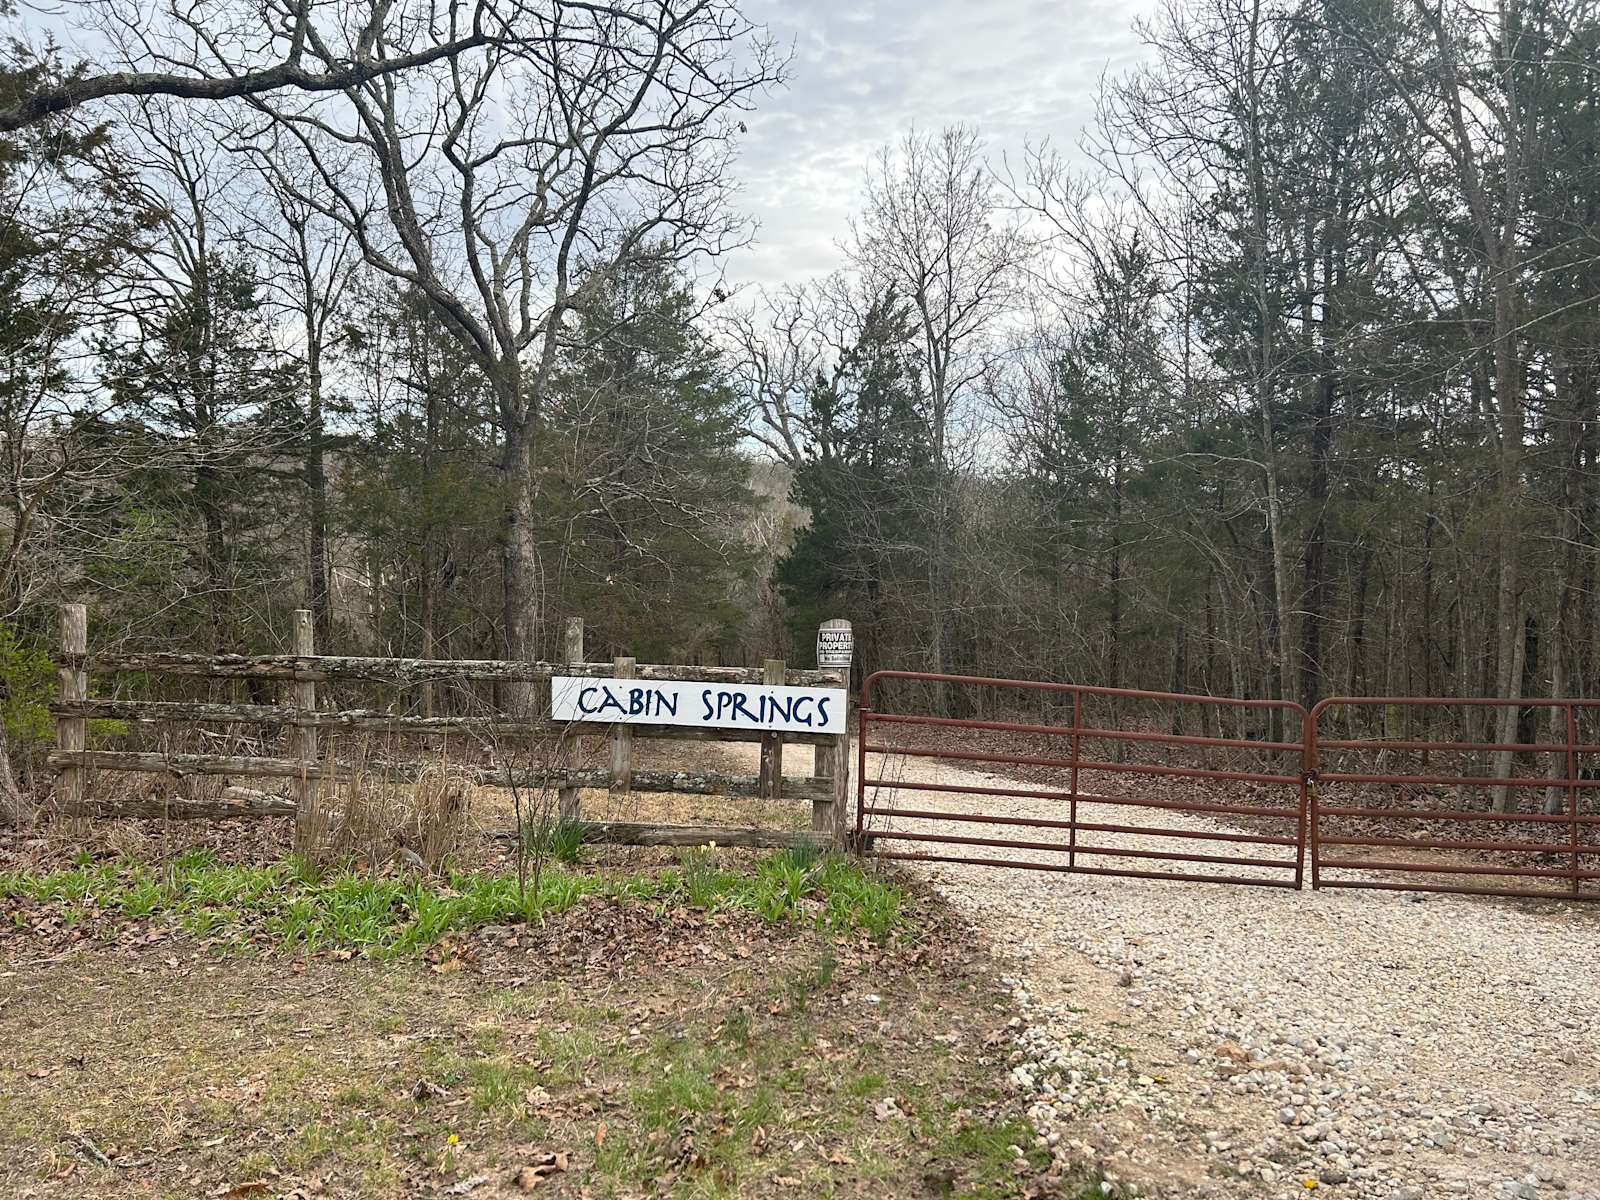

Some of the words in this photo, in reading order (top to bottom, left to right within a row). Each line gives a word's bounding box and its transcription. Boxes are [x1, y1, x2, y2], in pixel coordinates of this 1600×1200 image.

[821, 632, 852, 642] PRIVATE
[819, 641, 853, 650] PROPERT
[578, 686, 678, 717] CABIN
[702, 689, 830, 727] SPRINGS
